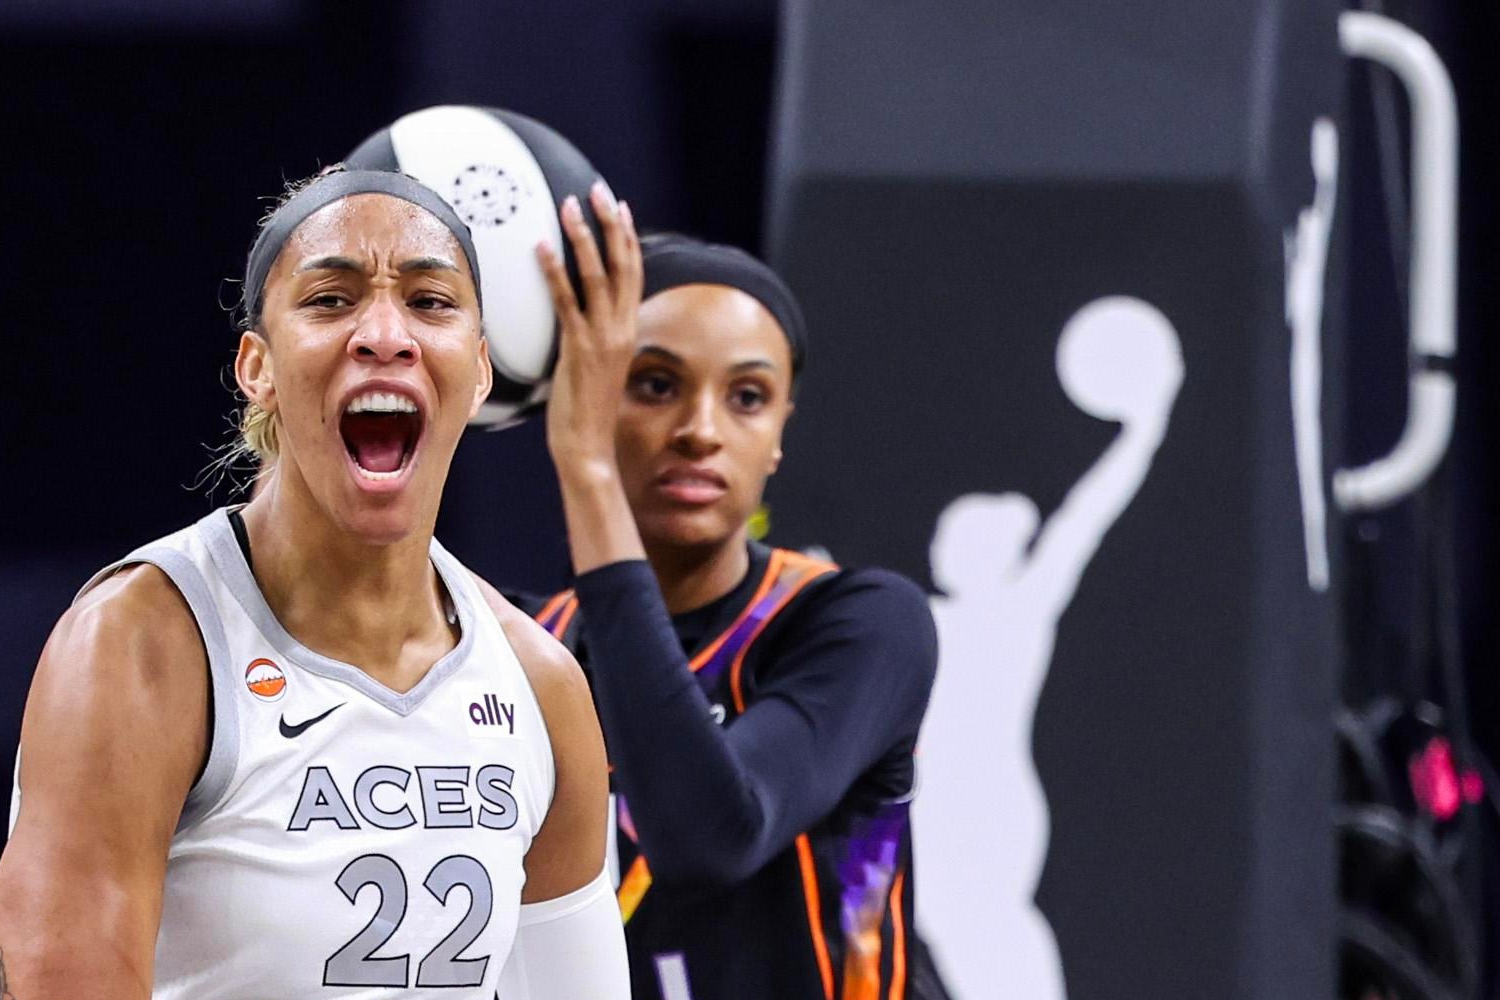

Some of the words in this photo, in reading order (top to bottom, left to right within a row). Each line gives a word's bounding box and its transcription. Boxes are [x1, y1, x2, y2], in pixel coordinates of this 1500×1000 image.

[468, 693, 514, 735] ally
[286, 764, 519, 831] ACES
[322, 853, 494, 989] 22
